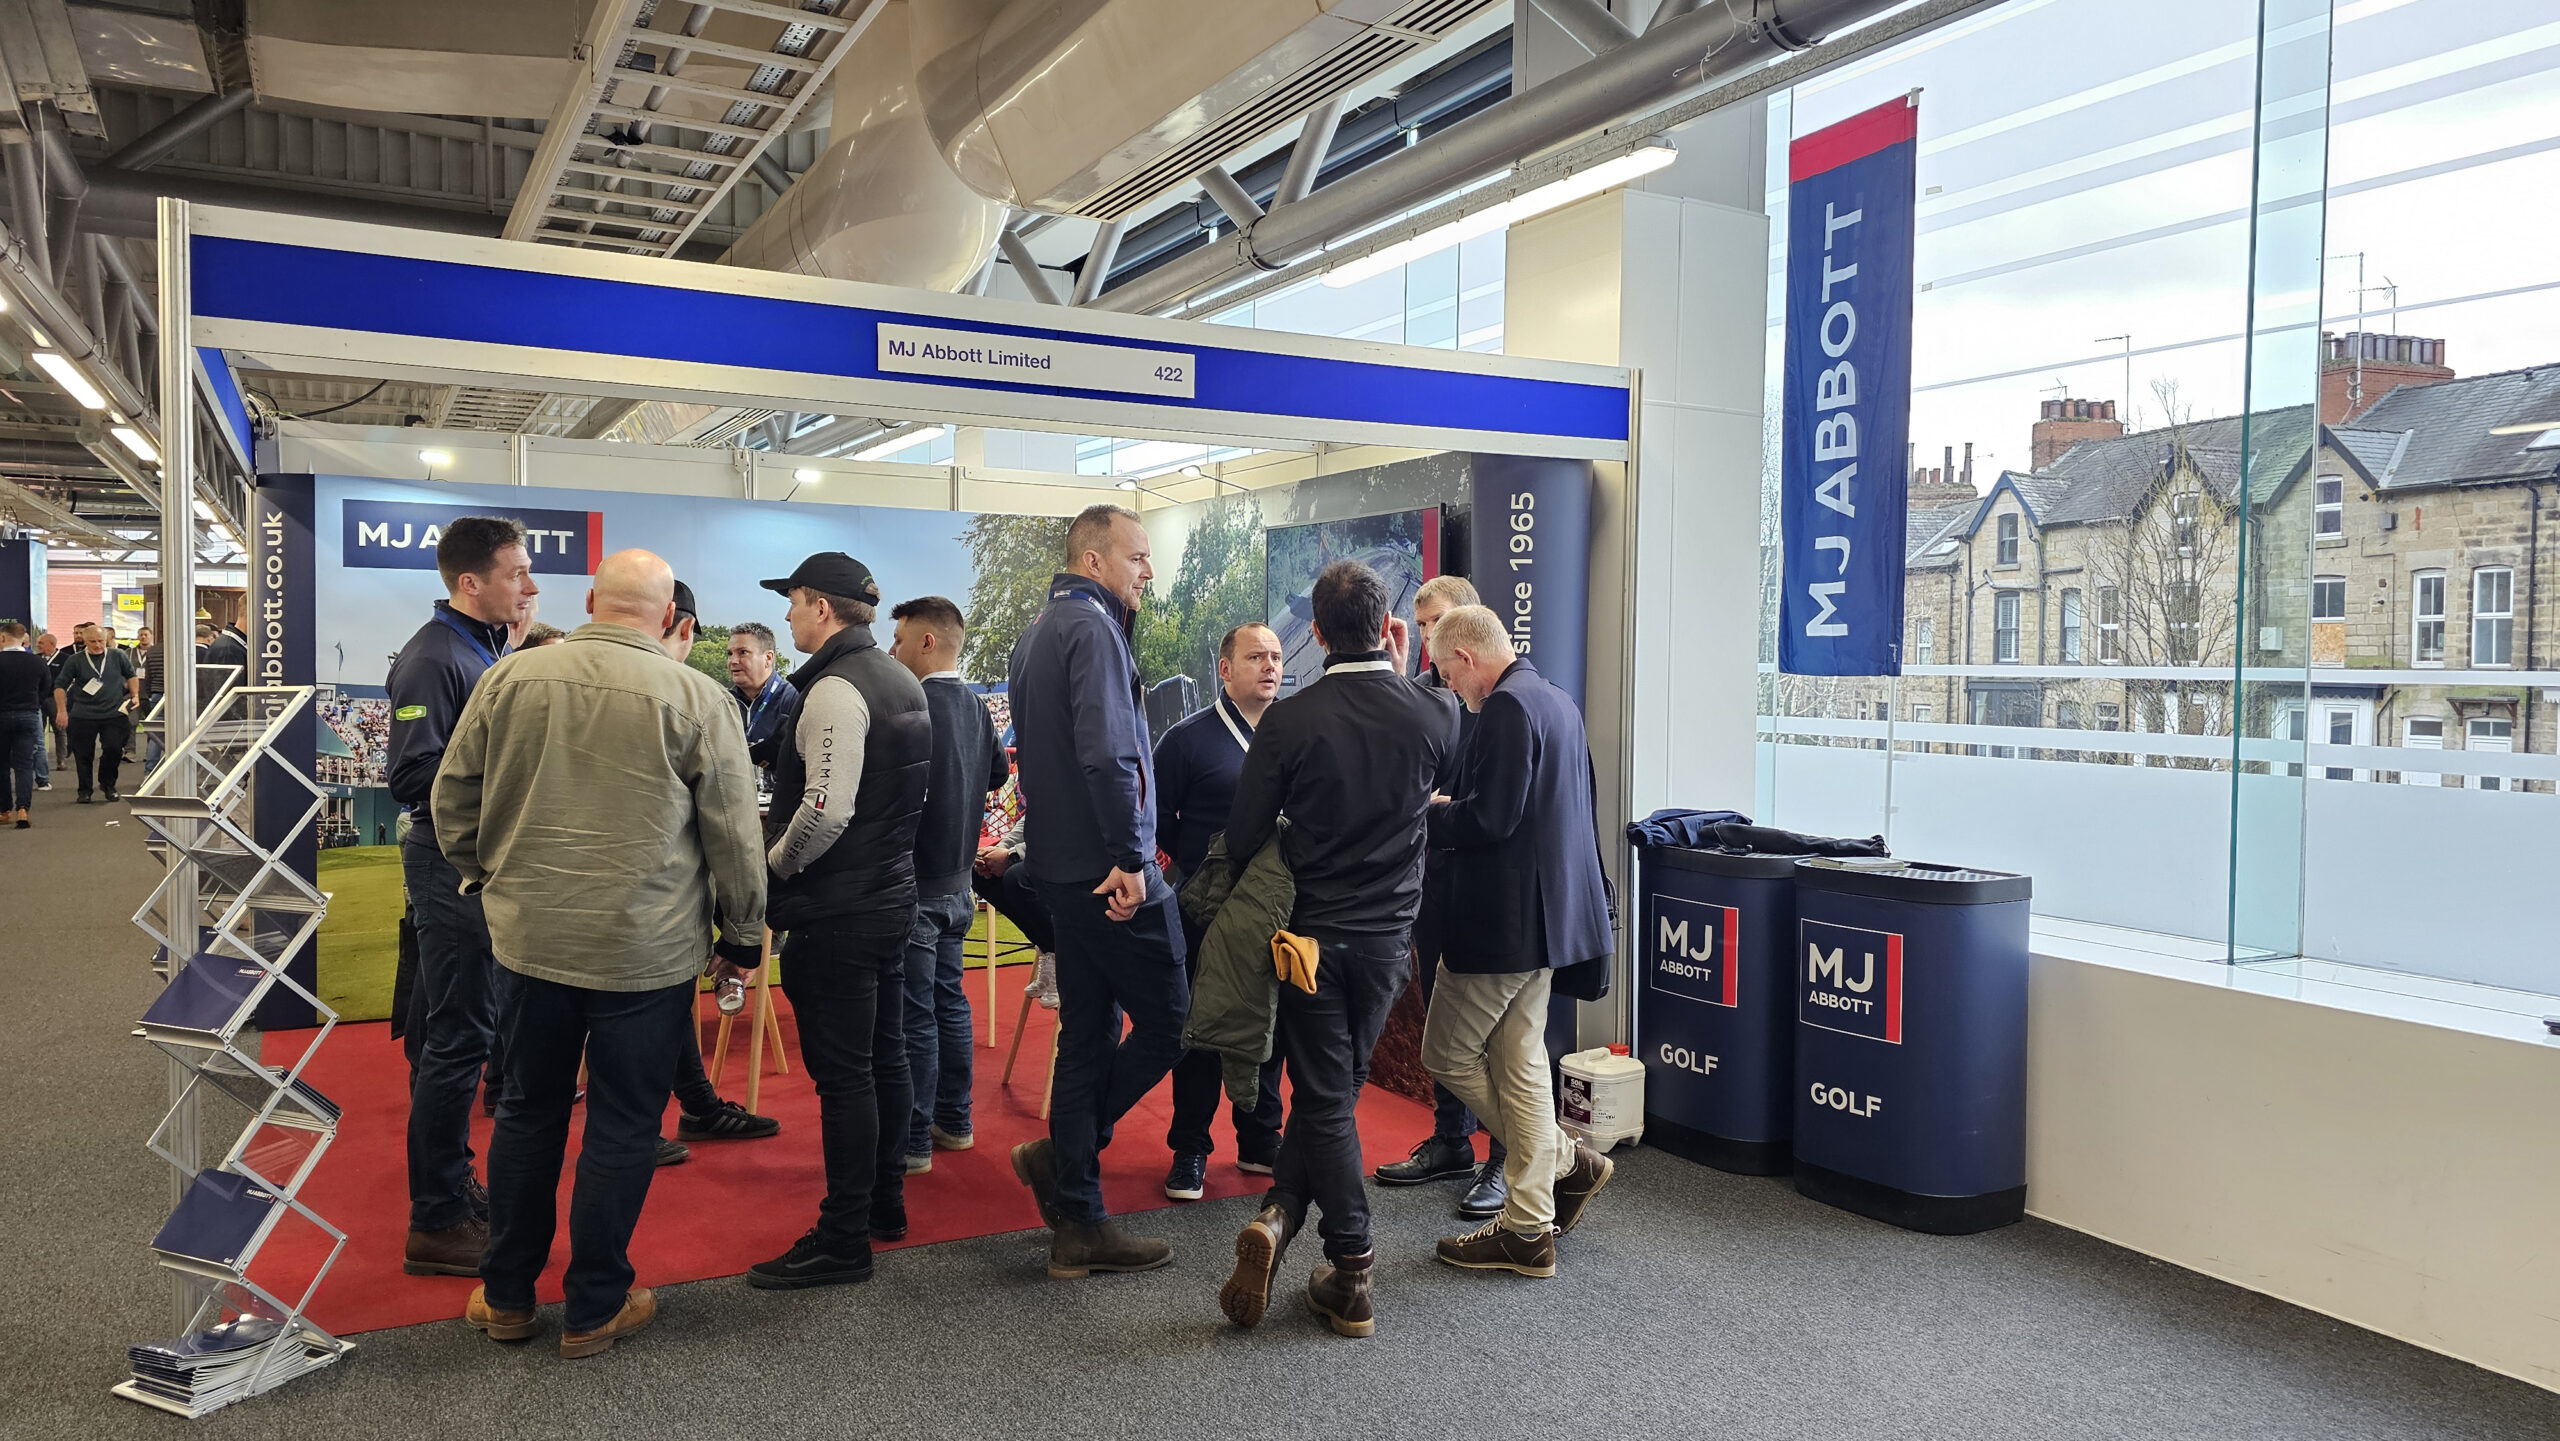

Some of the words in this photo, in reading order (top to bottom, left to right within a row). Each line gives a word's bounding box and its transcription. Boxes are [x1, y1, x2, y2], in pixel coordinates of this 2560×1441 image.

[888, 339, 915, 357] MJ
[922, 343, 982, 363] Abbott
[988, 350, 1050, 370] Limited
[1154, 366, 1183, 382] 422
[1815, 202, 1862, 518] ABBOTT
[358, 521, 412, 549] MJ
[419, 524, 574, 554] ATT
[1510, 492, 1535, 571] 1965
[1806, 535, 1850, 637] MJ
[1509, 582, 1533, 654] since
[819, 725, 834, 791] TOMMY
[785, 810, 823, 861] HILFIGER
[1660, 915, 1713, 962] MJ
[1660, 959, 1712, 982] ABBOTT
[1809, 942, 1874, 993] MJ
[1808, 990, 1873, 1015] ABBOTT
[1660, 1043, 1719, 1075] GOLF
[1810, 1082, 1882, 1118] GOLF
